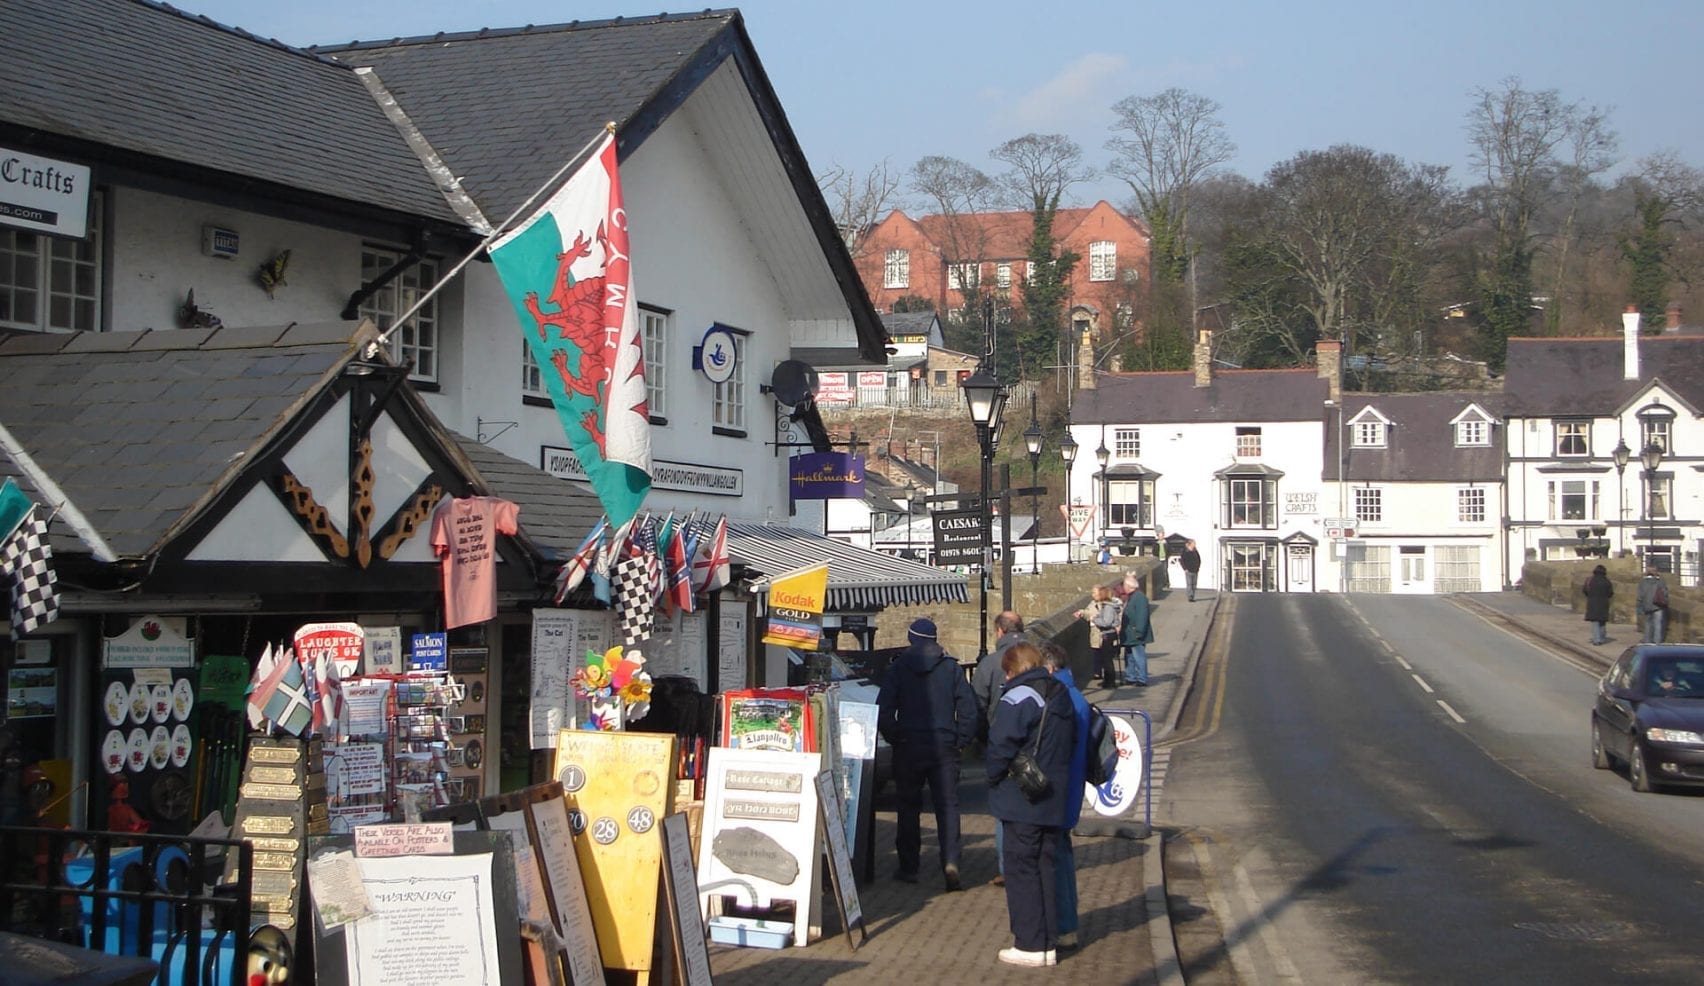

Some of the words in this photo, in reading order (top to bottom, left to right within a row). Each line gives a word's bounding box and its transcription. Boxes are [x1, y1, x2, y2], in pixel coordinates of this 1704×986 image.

[1, 158, 75, 194] Crafts
[791, 470, 862, 488] Hallmark
[774, 591, 815, 608] Kodak
[776, 608, 811, 620] GOLD
[300, 636, 361, 648] LAUGHTER
[415, 638, 443, 648] SALMON
[567, 770, 575, 786] 1
[628, 809, 652, 828] 48
[595, 821, 616, 838] 28
